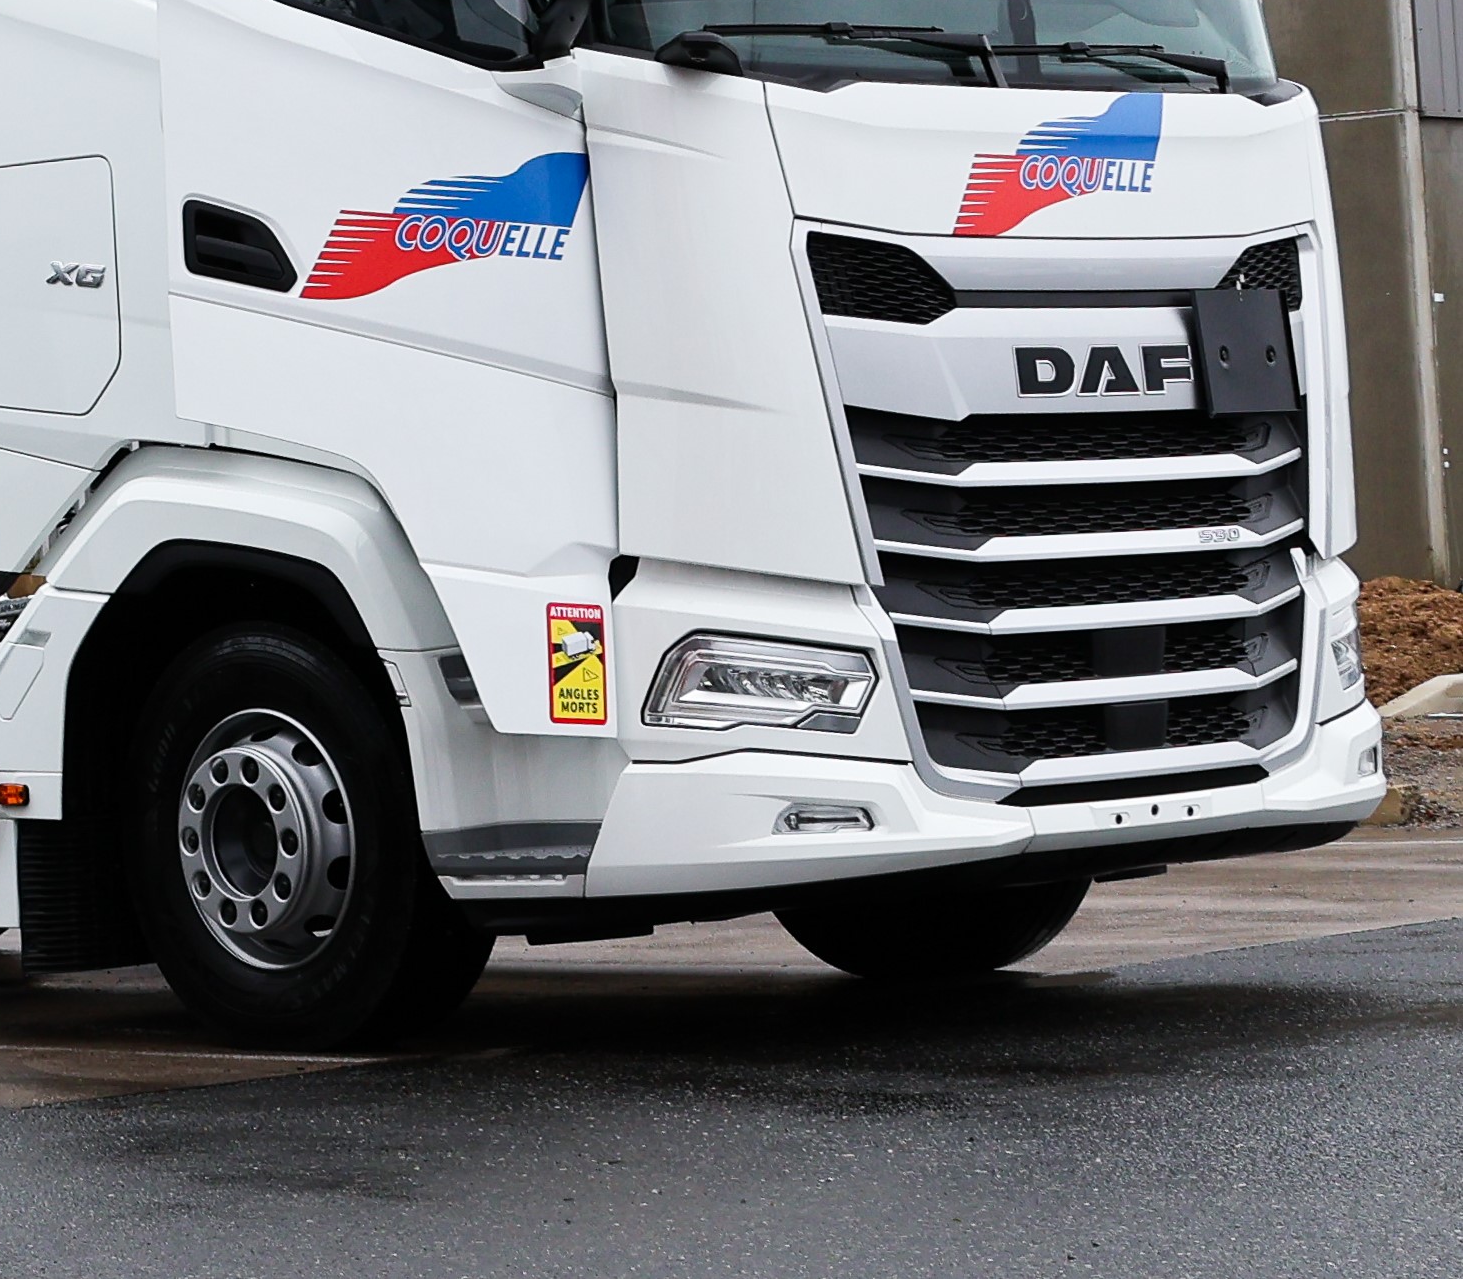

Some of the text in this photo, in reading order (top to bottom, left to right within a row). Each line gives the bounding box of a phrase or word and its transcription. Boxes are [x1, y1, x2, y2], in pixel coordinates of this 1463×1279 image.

[1020, 154, 1155, 196] COQUELLE
[395, 214, 570, 261] COQUELLE
[46, 261, 106, 289] XG
[1012, 343, 1194, 398] DAF
[1199, 527, 1240, 543] 530
[550, 606, 601, 619] ATTENTION
[559, 687, 599, 700] ANGLES
[561, 701, 598, 714] MORTS
